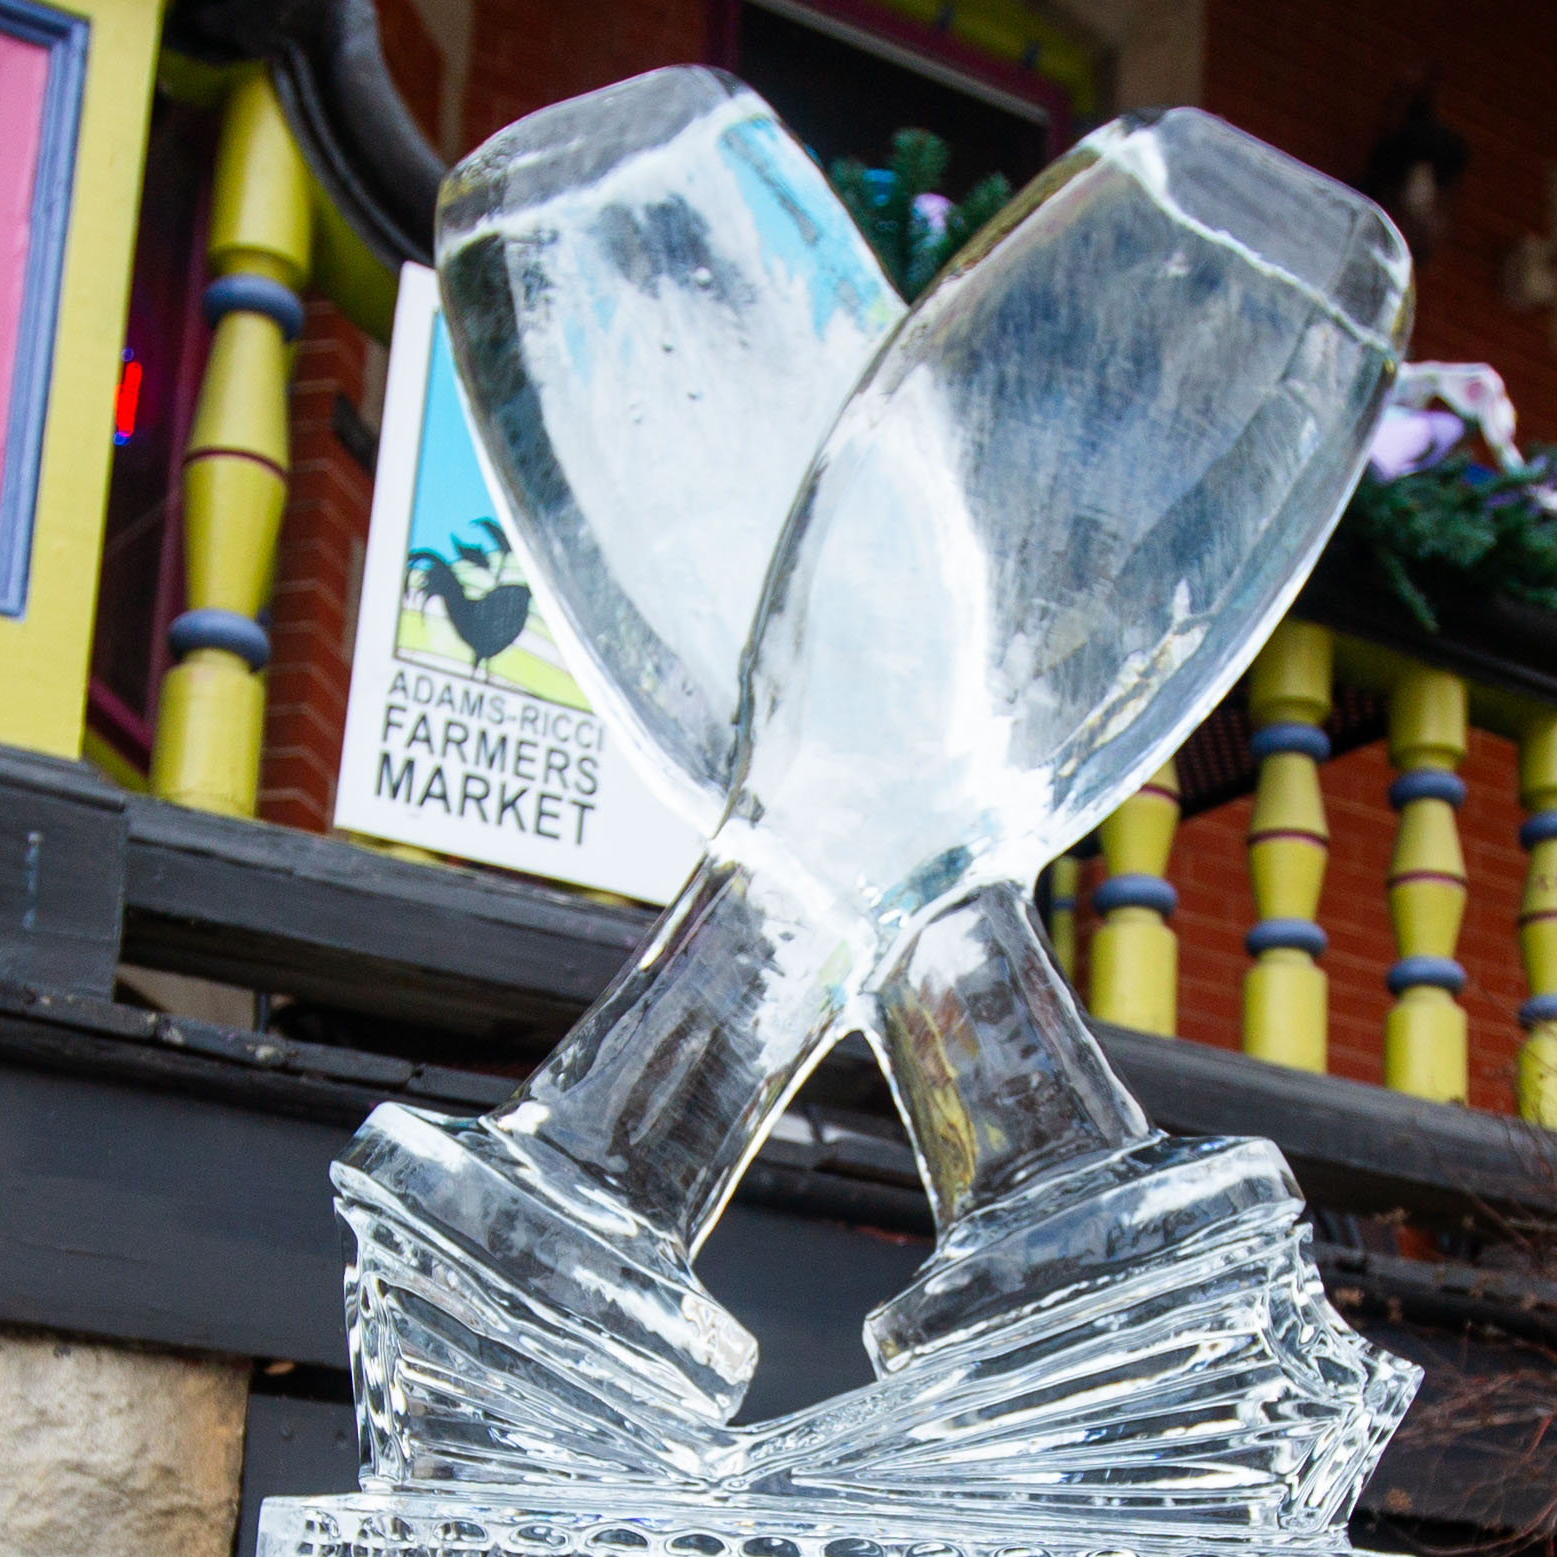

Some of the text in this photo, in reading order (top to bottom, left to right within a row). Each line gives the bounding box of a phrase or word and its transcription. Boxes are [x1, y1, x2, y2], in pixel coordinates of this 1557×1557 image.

[381, 704, 600, 796] FARMERS
[388, 669, 606, 752] ADAMS-RICCI
[374, 751, 597, 845] MARKET
